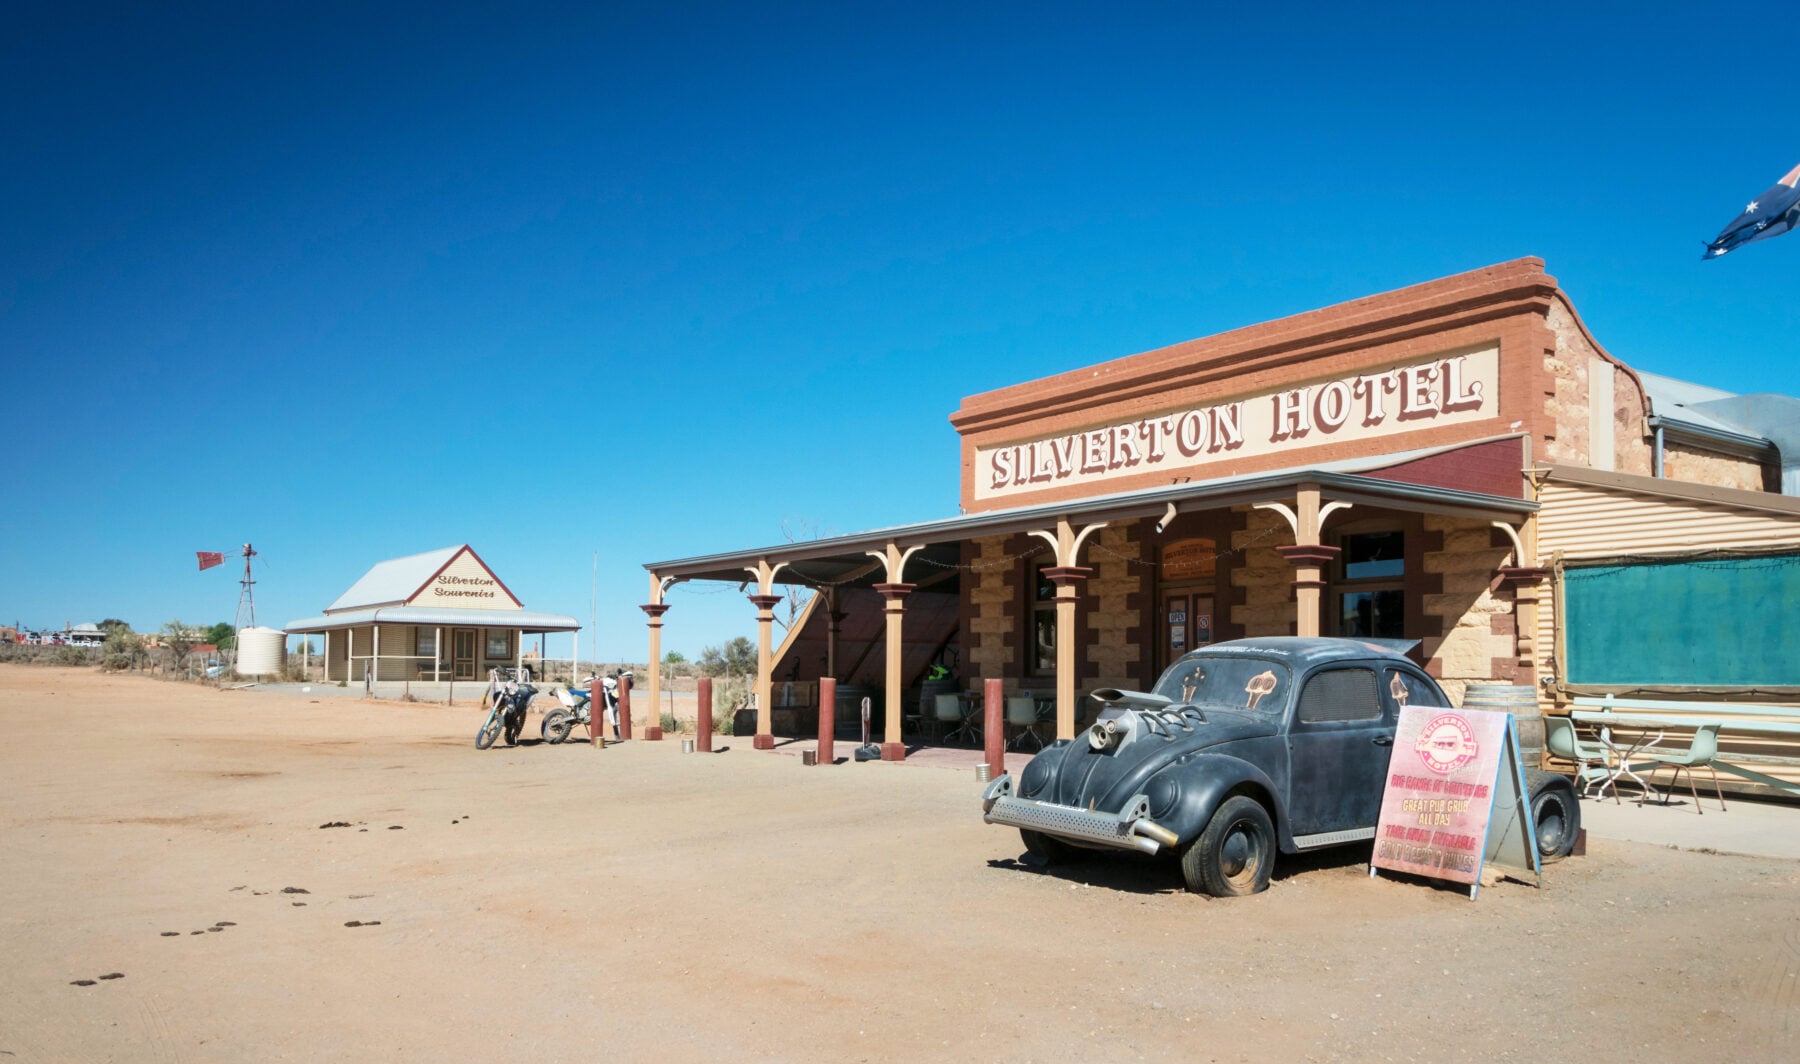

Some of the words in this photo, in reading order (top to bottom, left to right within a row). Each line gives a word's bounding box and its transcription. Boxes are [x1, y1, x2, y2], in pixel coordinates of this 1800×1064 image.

[990, 400, 1246, 489] SILVERTON
[1269, 355, 1484, 442] HOTEL
[437, 575, 495, 586] Silverton
[434, 587, 495, 598] Souvenirs
[1170, 613, 1185, 621] OPEN
[1423, 717, 1471, 740] SILVERTON
[1427, 757, 1462, 770] HOTEL
[1402, 798, 1428, 812] GREAT
[1429, 799, 1445, 813] PUB
[1447, 800, 1469, 813] GRUB
[1418, 813, 1433, 825] ALL
[1434, 813, 1450, 826] DAY
[1379, 840, 1403, 860] COLD
